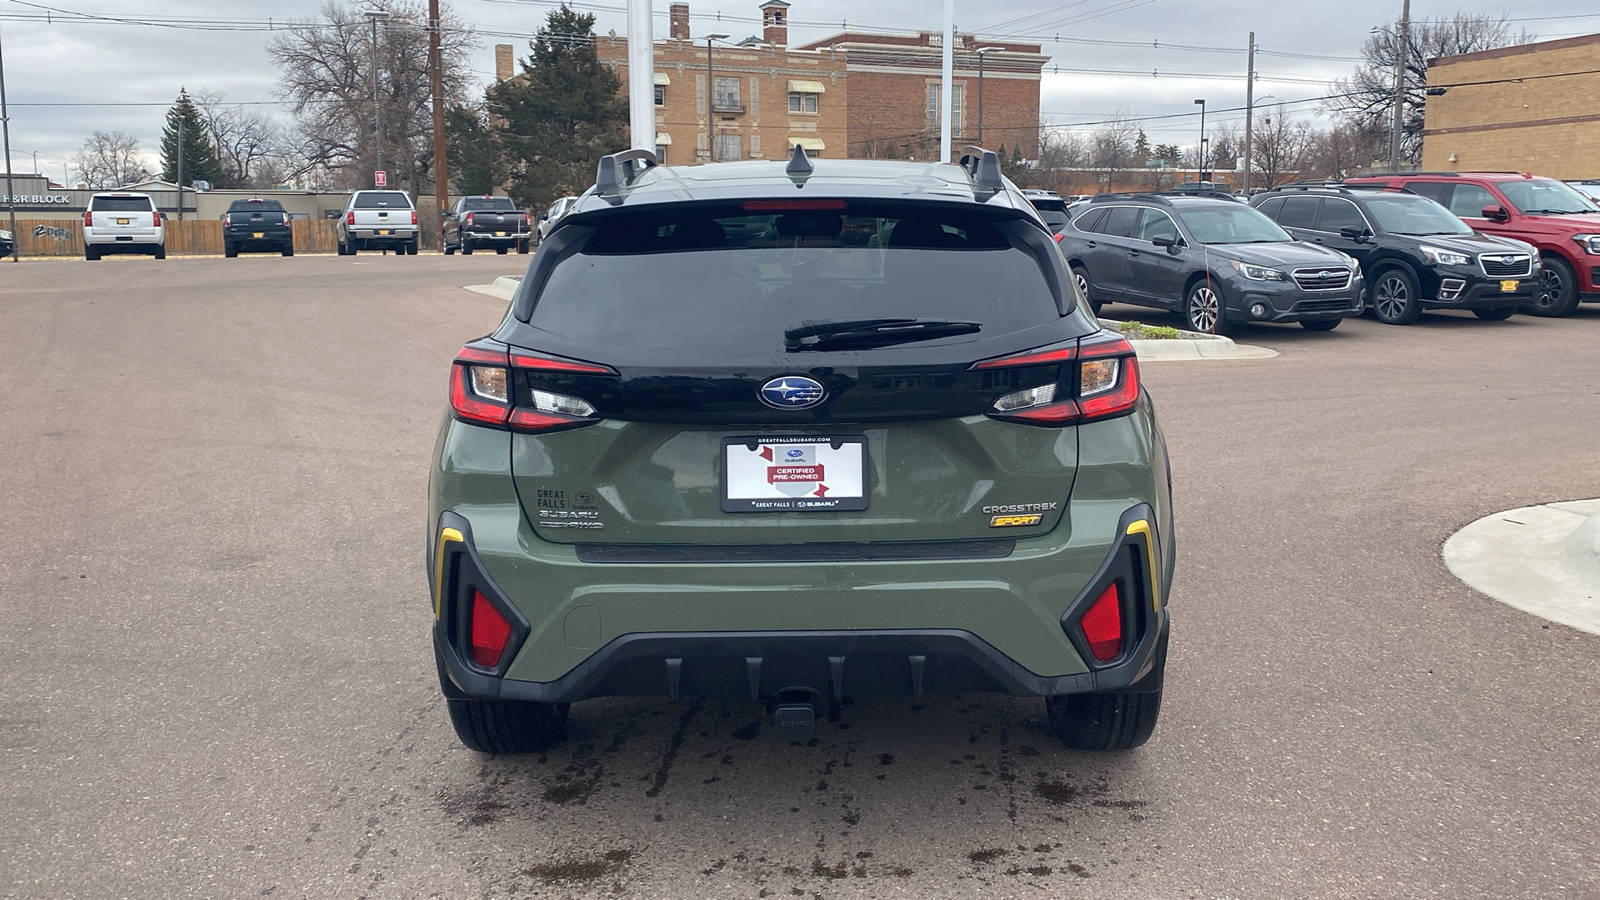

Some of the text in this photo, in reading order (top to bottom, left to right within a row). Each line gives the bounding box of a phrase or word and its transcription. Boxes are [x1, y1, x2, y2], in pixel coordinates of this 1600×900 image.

[3, 194, 70, 203] H&R BLOCK
[537, 489, 564, 499] GREAT
[537, 498, 565, 509] FALLS
[982, 501, 1058, 514] CROSSTREK
[539, 509, 599, 519] SUBARU
[994, 515, 1039, 526] SPORT
